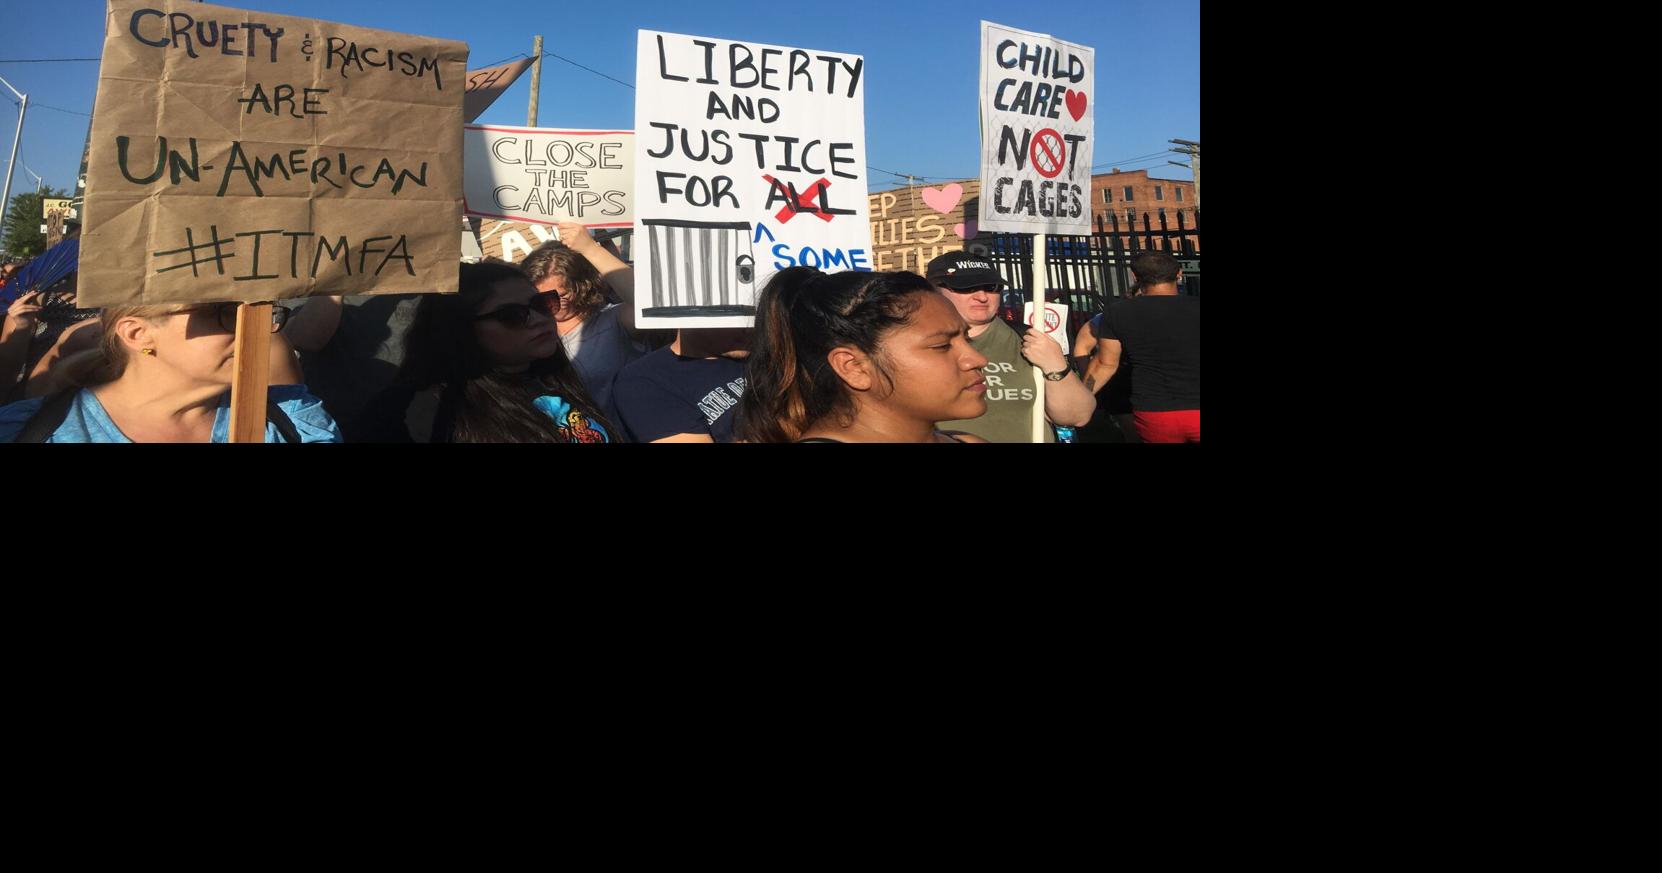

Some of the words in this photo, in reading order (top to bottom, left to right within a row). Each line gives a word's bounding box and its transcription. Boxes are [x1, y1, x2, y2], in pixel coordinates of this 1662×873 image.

[129, 8, 285, 63] CRUETY
[326, 36, 442, 91] RACISM
[656, 34, 864, 99] LIBERTY
[996, 39, 1085, 84] CHILD
[237, 83, 330, 119] ARE
[706, 90, 780, 124] AND
[993, 78, 1067, 120] CARE
[116, 135, 428, 198] UN-AMERICAN
[492, 136, 623, 170] CLOSE
[646, 121, 858, 180] JUSTICE
[525, 168, 590, 189] THE
[655, 170, 740, 209] FOR
[764, 177, 857, 216] ALL
[993, 176, 1083, 219] CAGES
[492, 184, 626, 218] CAMPS
[153, 224, 416, 281] #ITMFA
[771, 243, 872, 272] SOME
